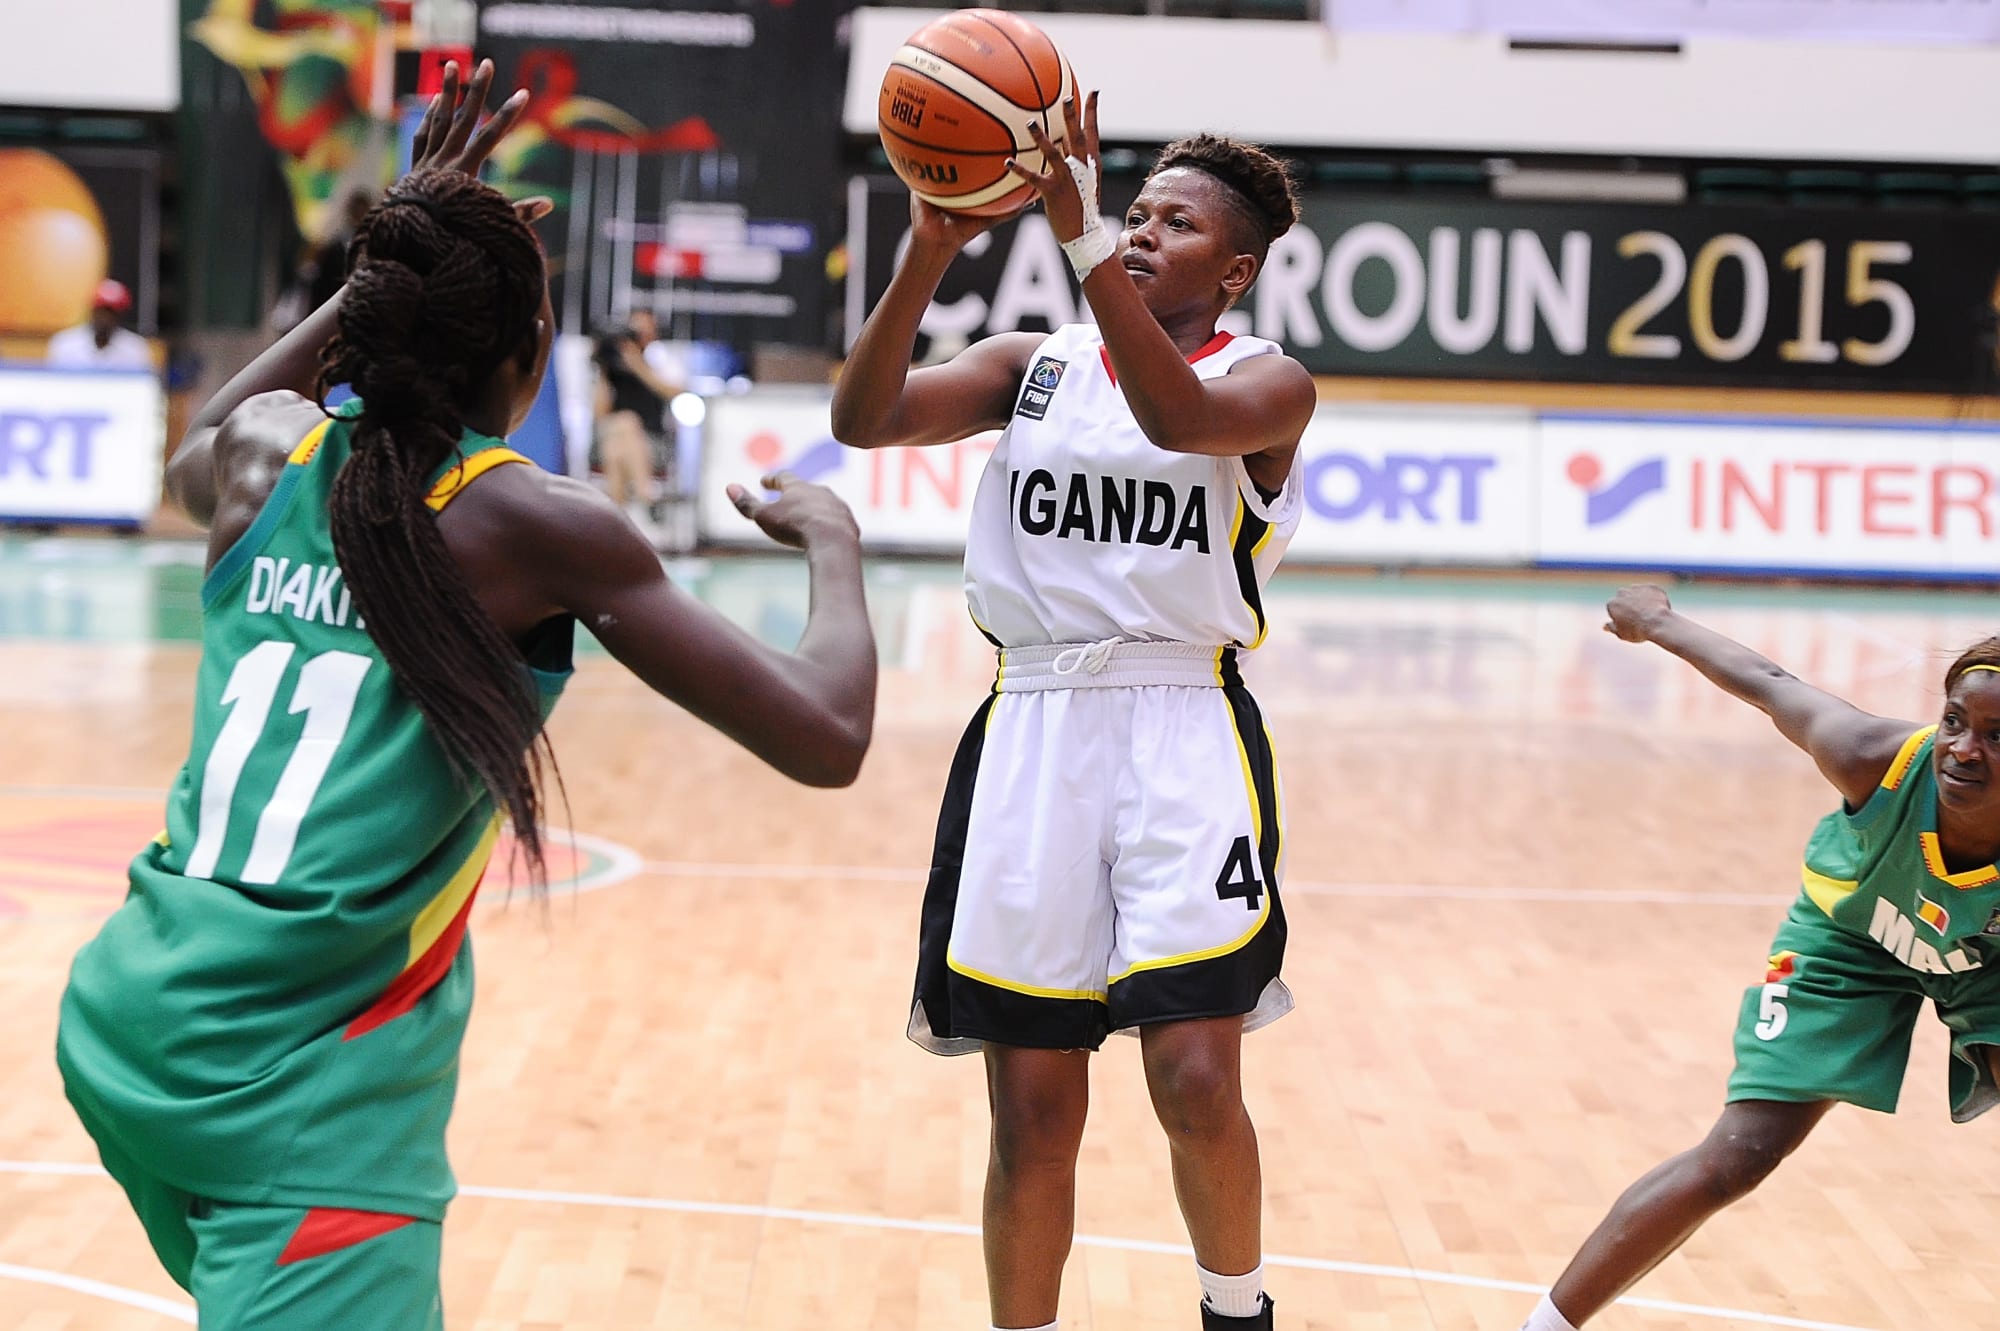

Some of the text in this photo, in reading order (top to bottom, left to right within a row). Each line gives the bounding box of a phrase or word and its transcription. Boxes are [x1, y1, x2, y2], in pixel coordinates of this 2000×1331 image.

[891, 95, 924, 130] FIBA
[893, 213, 1916, 365] CAROUN 2015
[1025, 389, 1049, 405] FIBA
[246, 556, 366, 630] DIAKI
[184, 640, 374, 885] 11
[1215, 835, 1264, 911] 4
[1754, 983, 1790, 1042] 5
